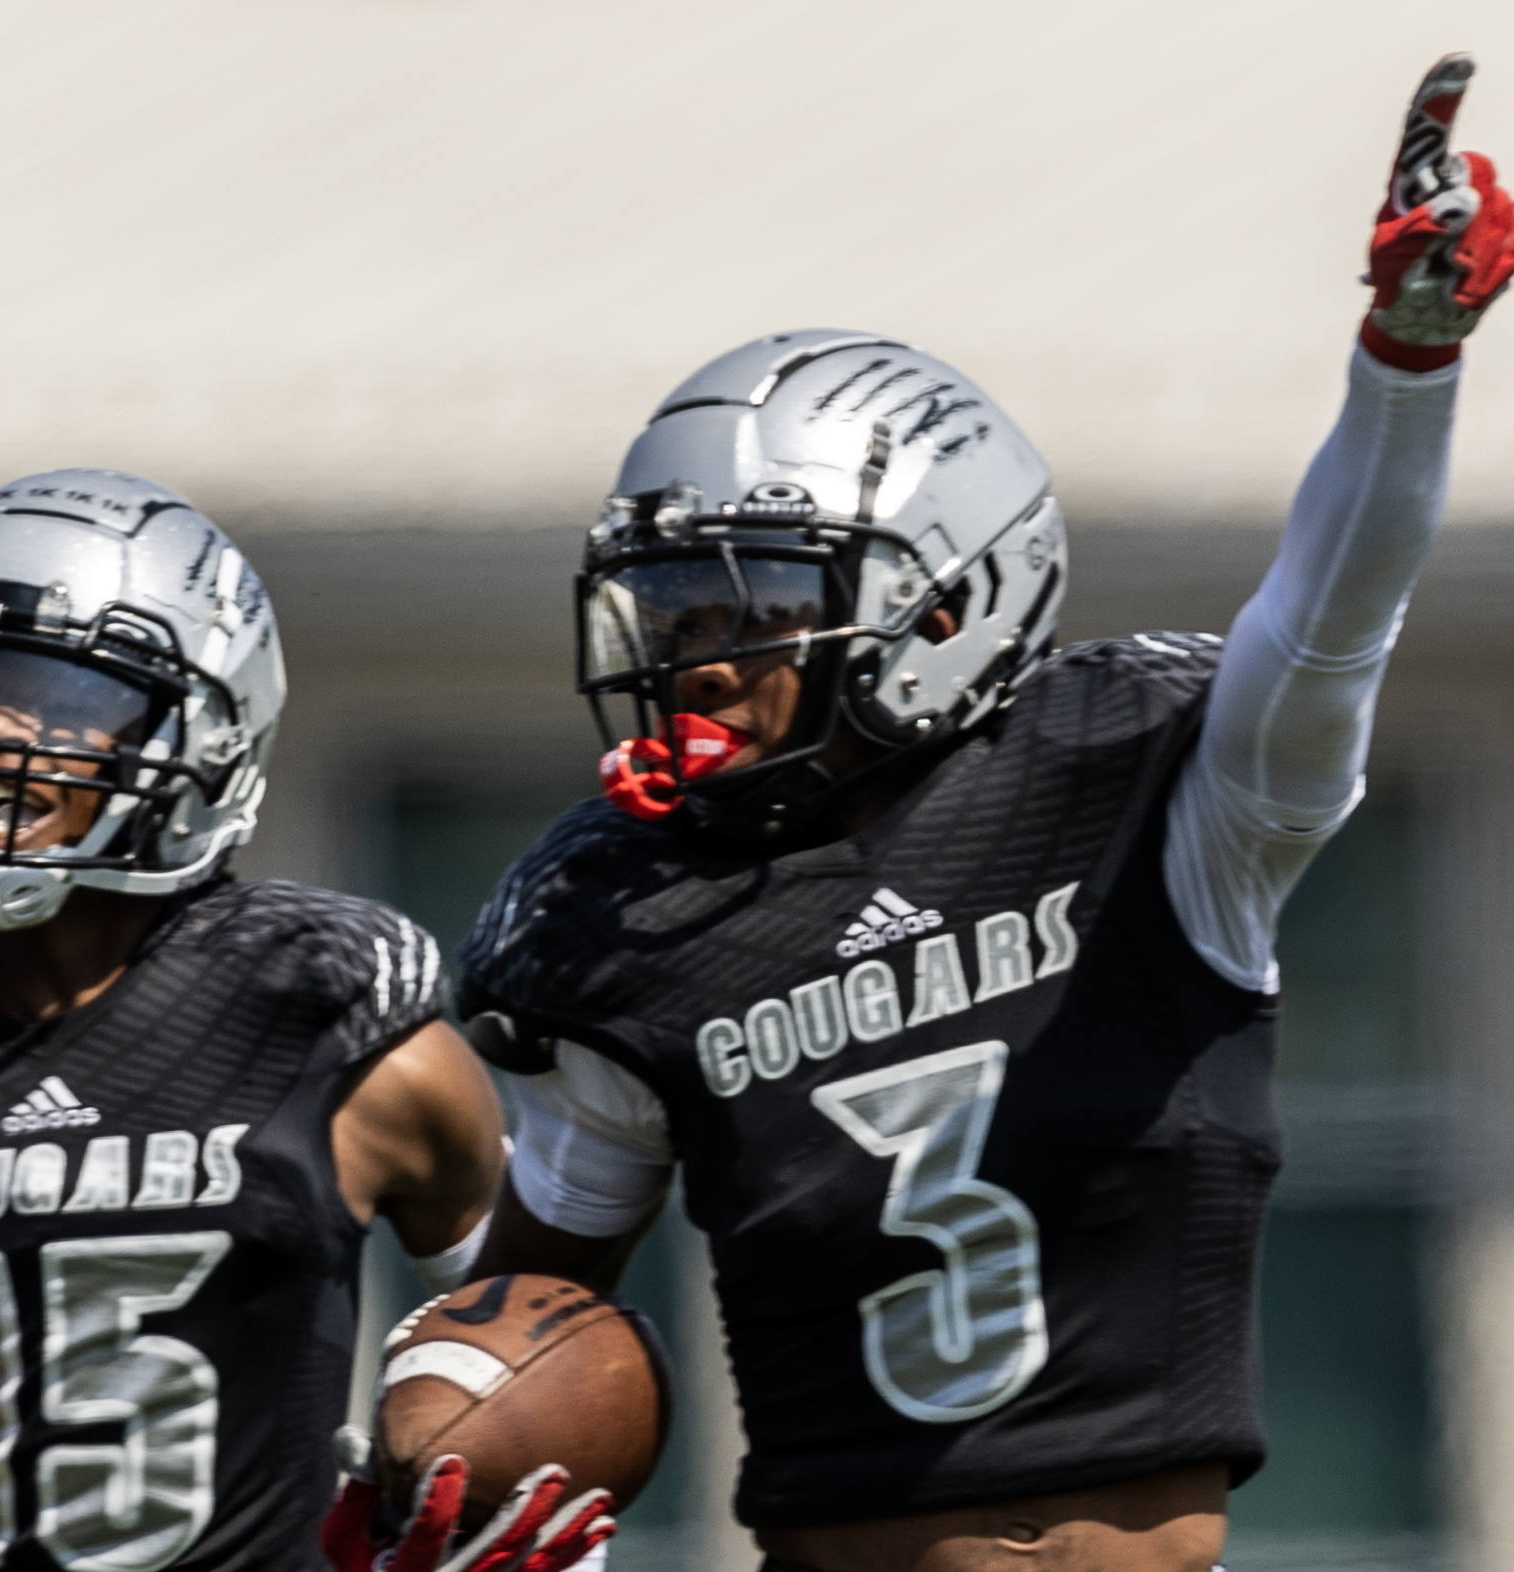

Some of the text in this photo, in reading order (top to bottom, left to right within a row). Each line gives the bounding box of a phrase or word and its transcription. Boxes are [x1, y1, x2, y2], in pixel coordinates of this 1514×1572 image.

[696, 881, 1081, 1098] COUGARS
[836, 908, 944, 956] adidas
[810, 1040, 1049, 1422] 3
